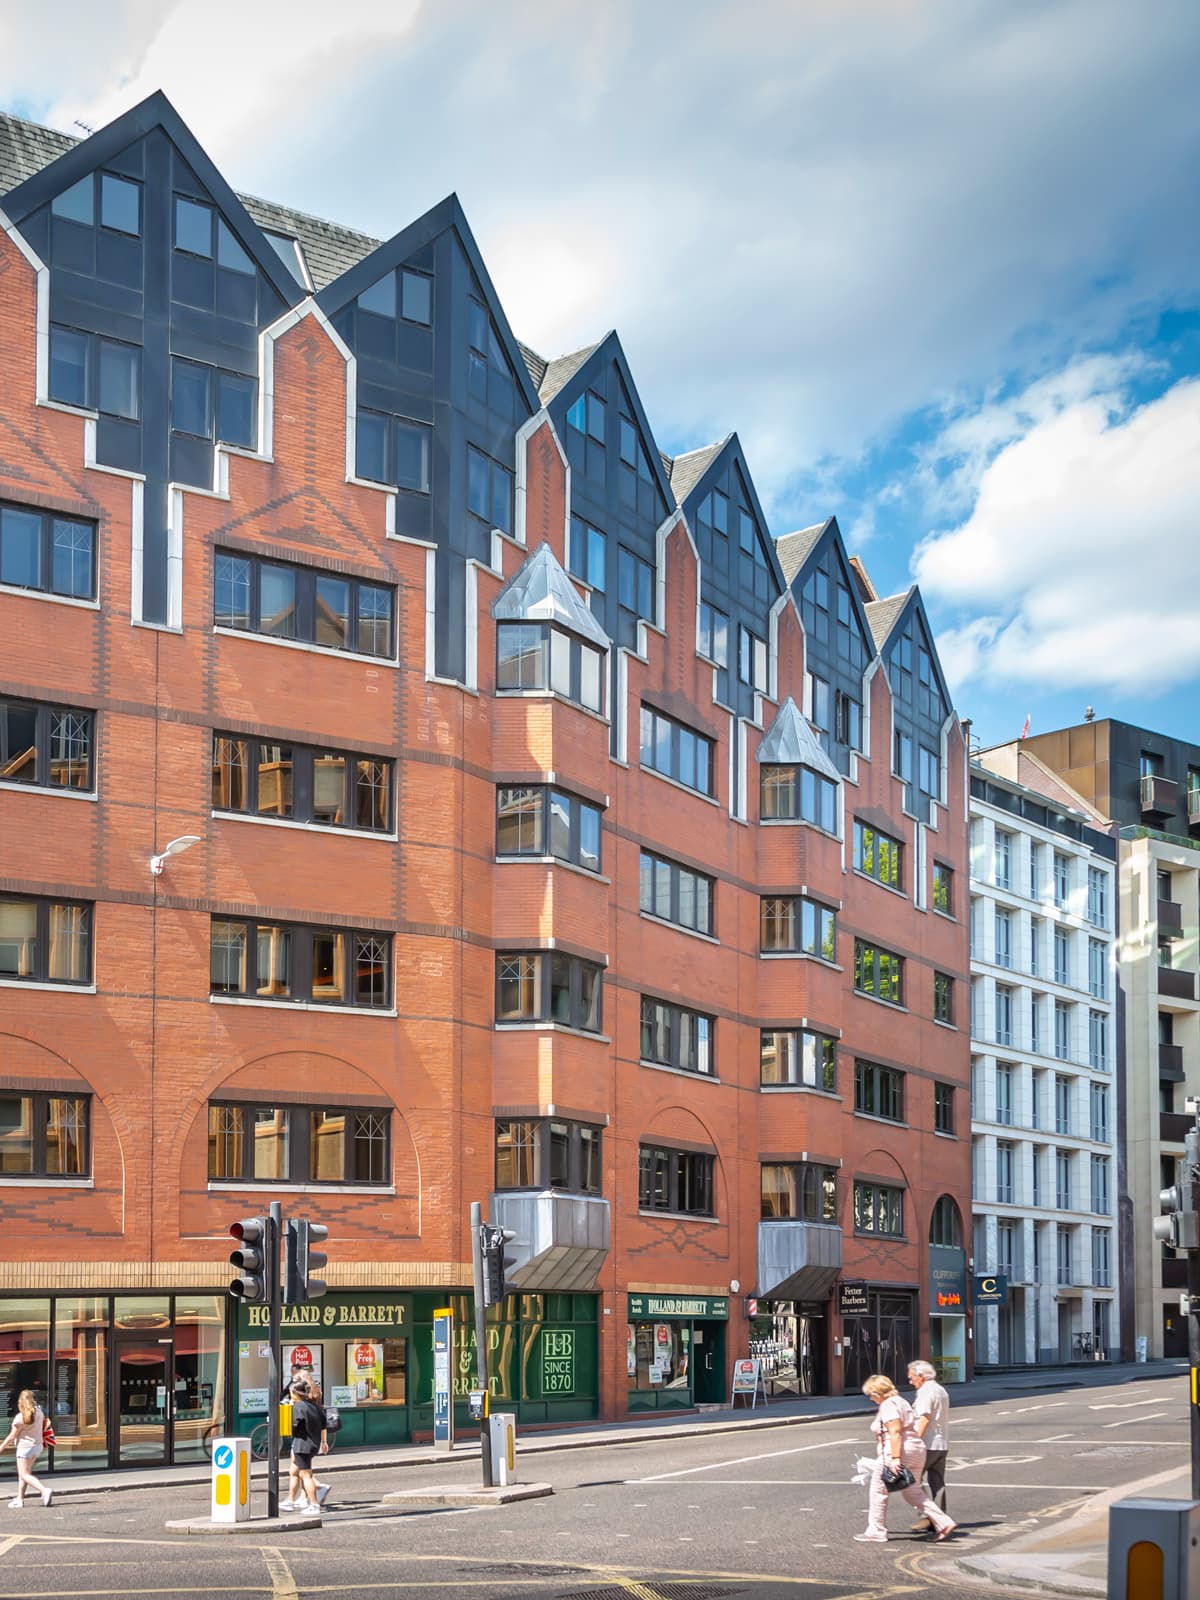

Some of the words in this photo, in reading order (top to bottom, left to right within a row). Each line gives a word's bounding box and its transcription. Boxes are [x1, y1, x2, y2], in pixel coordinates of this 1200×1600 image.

[982, 1279, 997, 1293] C
[248, 1306, 320, 1326] HOLAND
[323, 1306, 336, 1326] &
[339, 1306, 404, 1324] BARRETT
[358, 1354, 374, 1362] Free
[460, 1350, 472, 1373] &
[544, 1361, 571, 1374] SINCE
[545, 1374, 571, 1390] 1870
